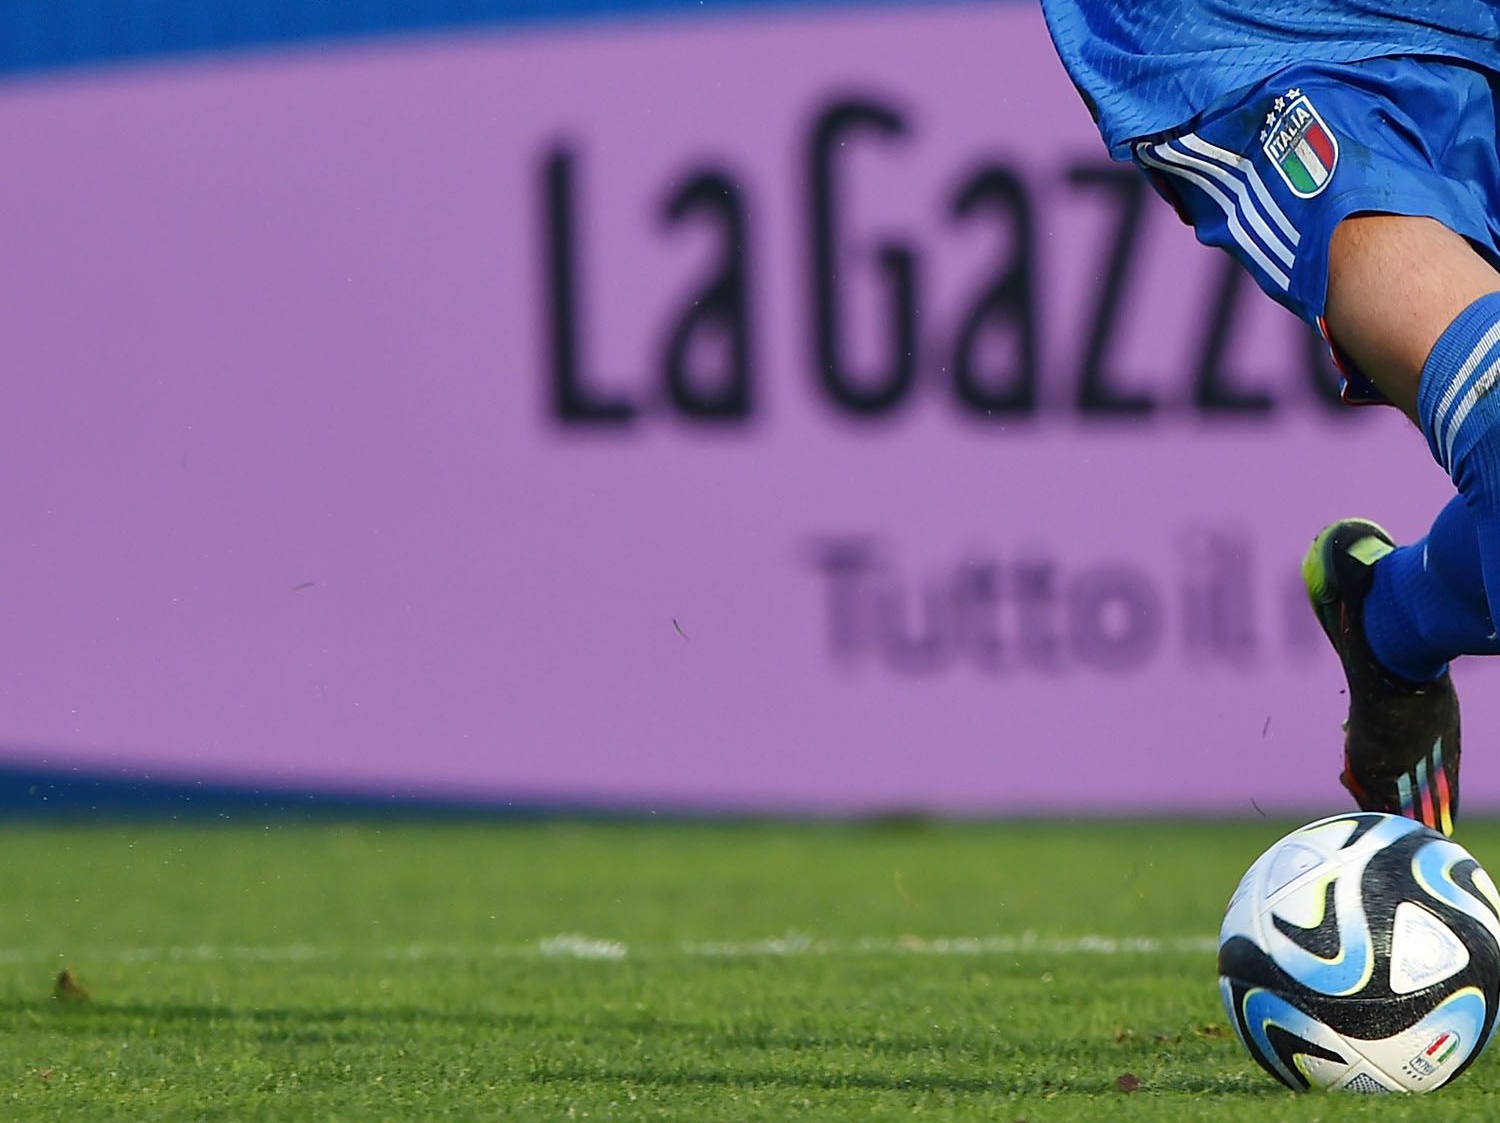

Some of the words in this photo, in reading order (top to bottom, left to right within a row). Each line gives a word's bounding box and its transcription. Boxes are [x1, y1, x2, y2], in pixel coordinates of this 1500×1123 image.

[1269, 107, 1311, 159] ITALIA
[808, 533, 1164, 678] Tutto
[1175, 516, 1256, 668] il
